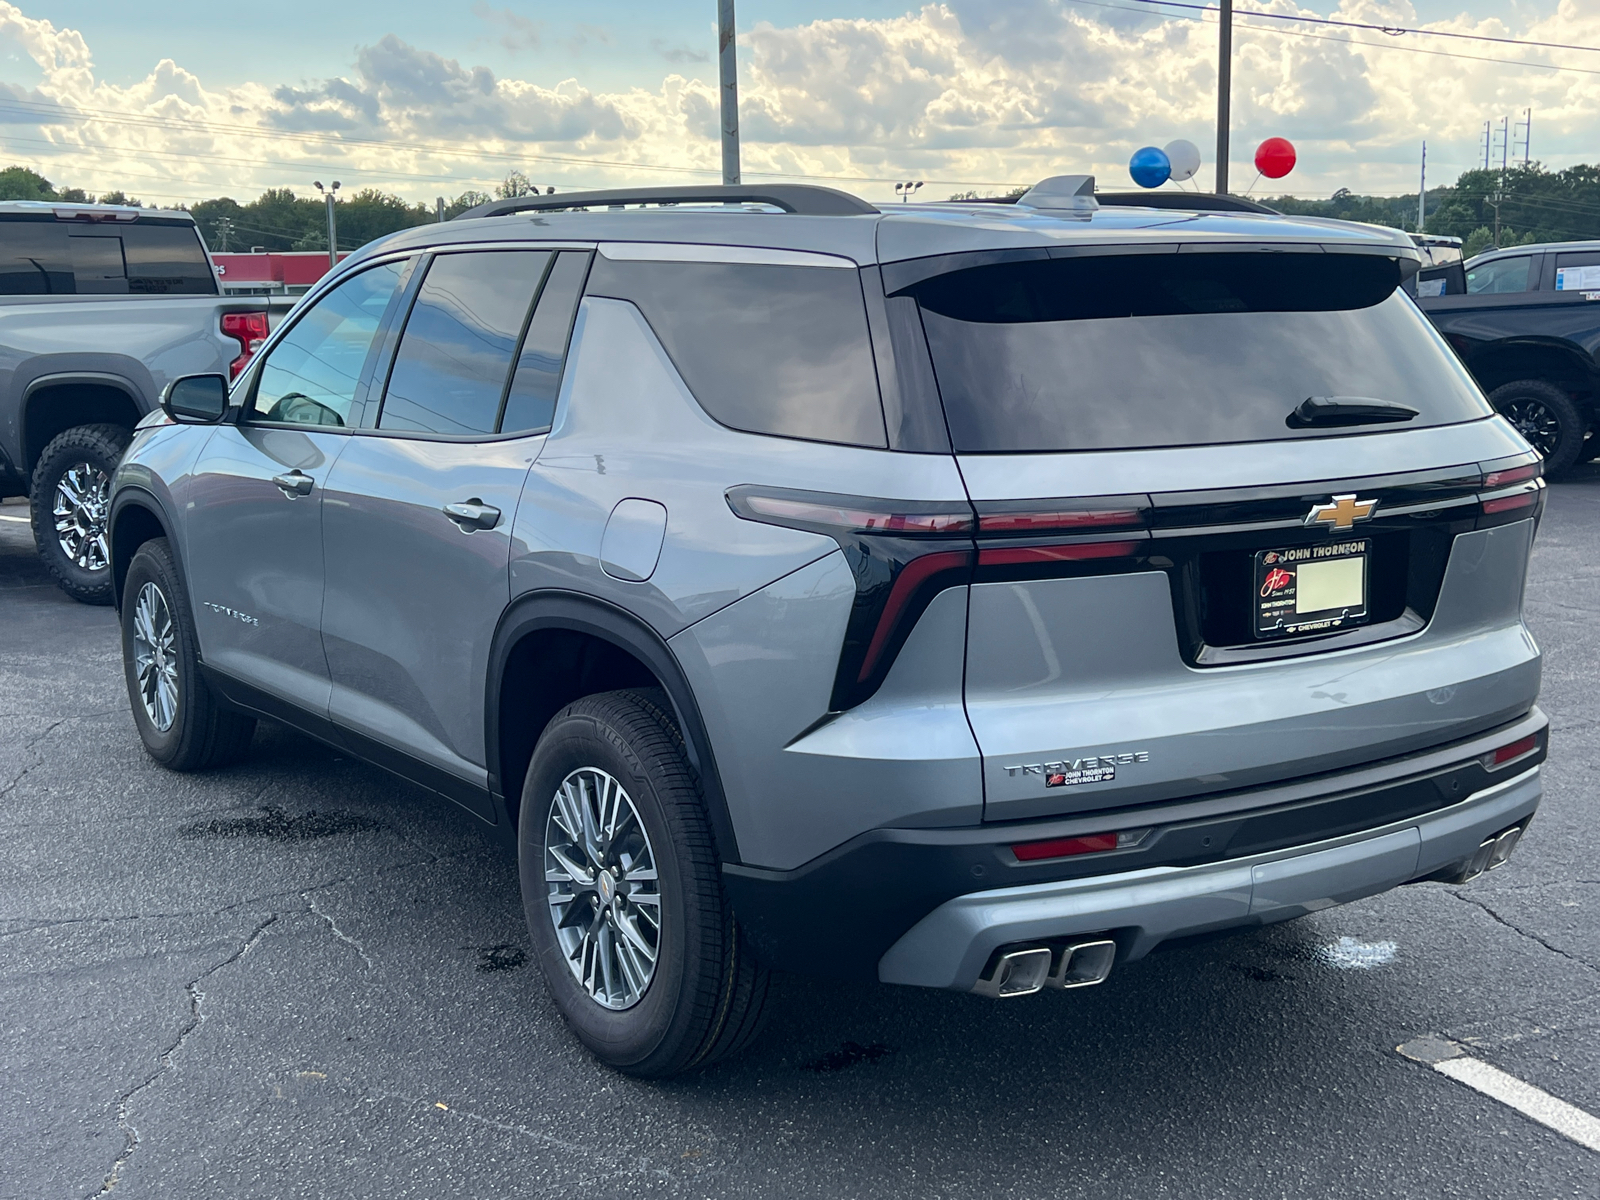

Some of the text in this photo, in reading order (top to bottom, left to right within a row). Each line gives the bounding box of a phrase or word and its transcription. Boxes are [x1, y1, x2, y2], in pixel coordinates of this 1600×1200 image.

[1284, 541, 1365, 561] JOHN THORNTON
[1298, 621, 1331, 631] CHEVROLET
[599, 727, 640, 772] ALENZA
[1003, 751, 1149, 777] TRAVERSE
[1065, 767, 1114, 779] JOHN THORNTON
[1065, 775, 1103, 785] CHEVROLET
